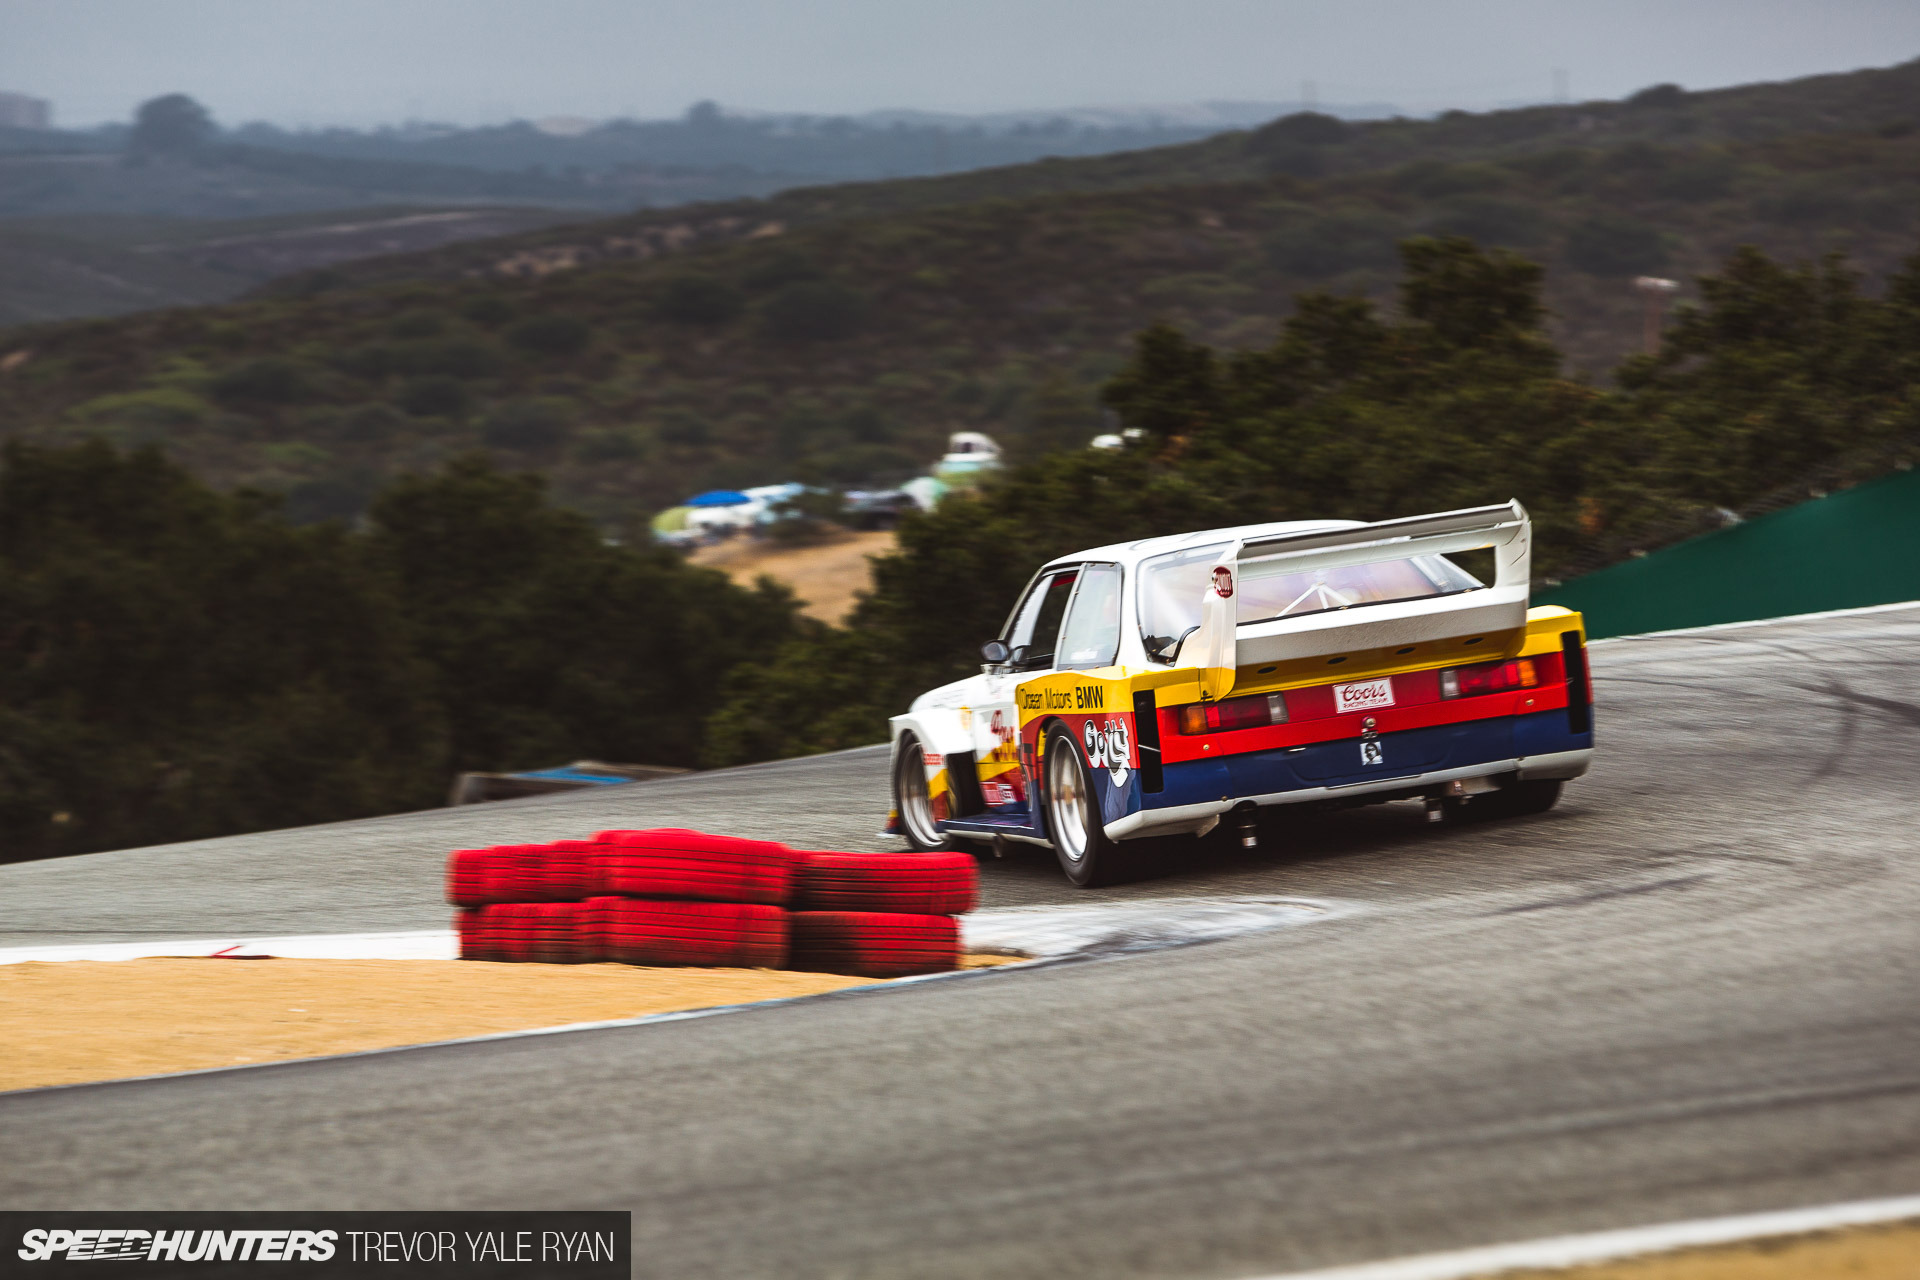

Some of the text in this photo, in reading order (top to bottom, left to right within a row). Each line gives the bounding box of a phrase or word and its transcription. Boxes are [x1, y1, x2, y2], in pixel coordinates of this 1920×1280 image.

[1045, 687, 1072, 710] Motors
[1075, 685, 1103, 709] BMW
[1341, 684, 1386, 702] Coors
